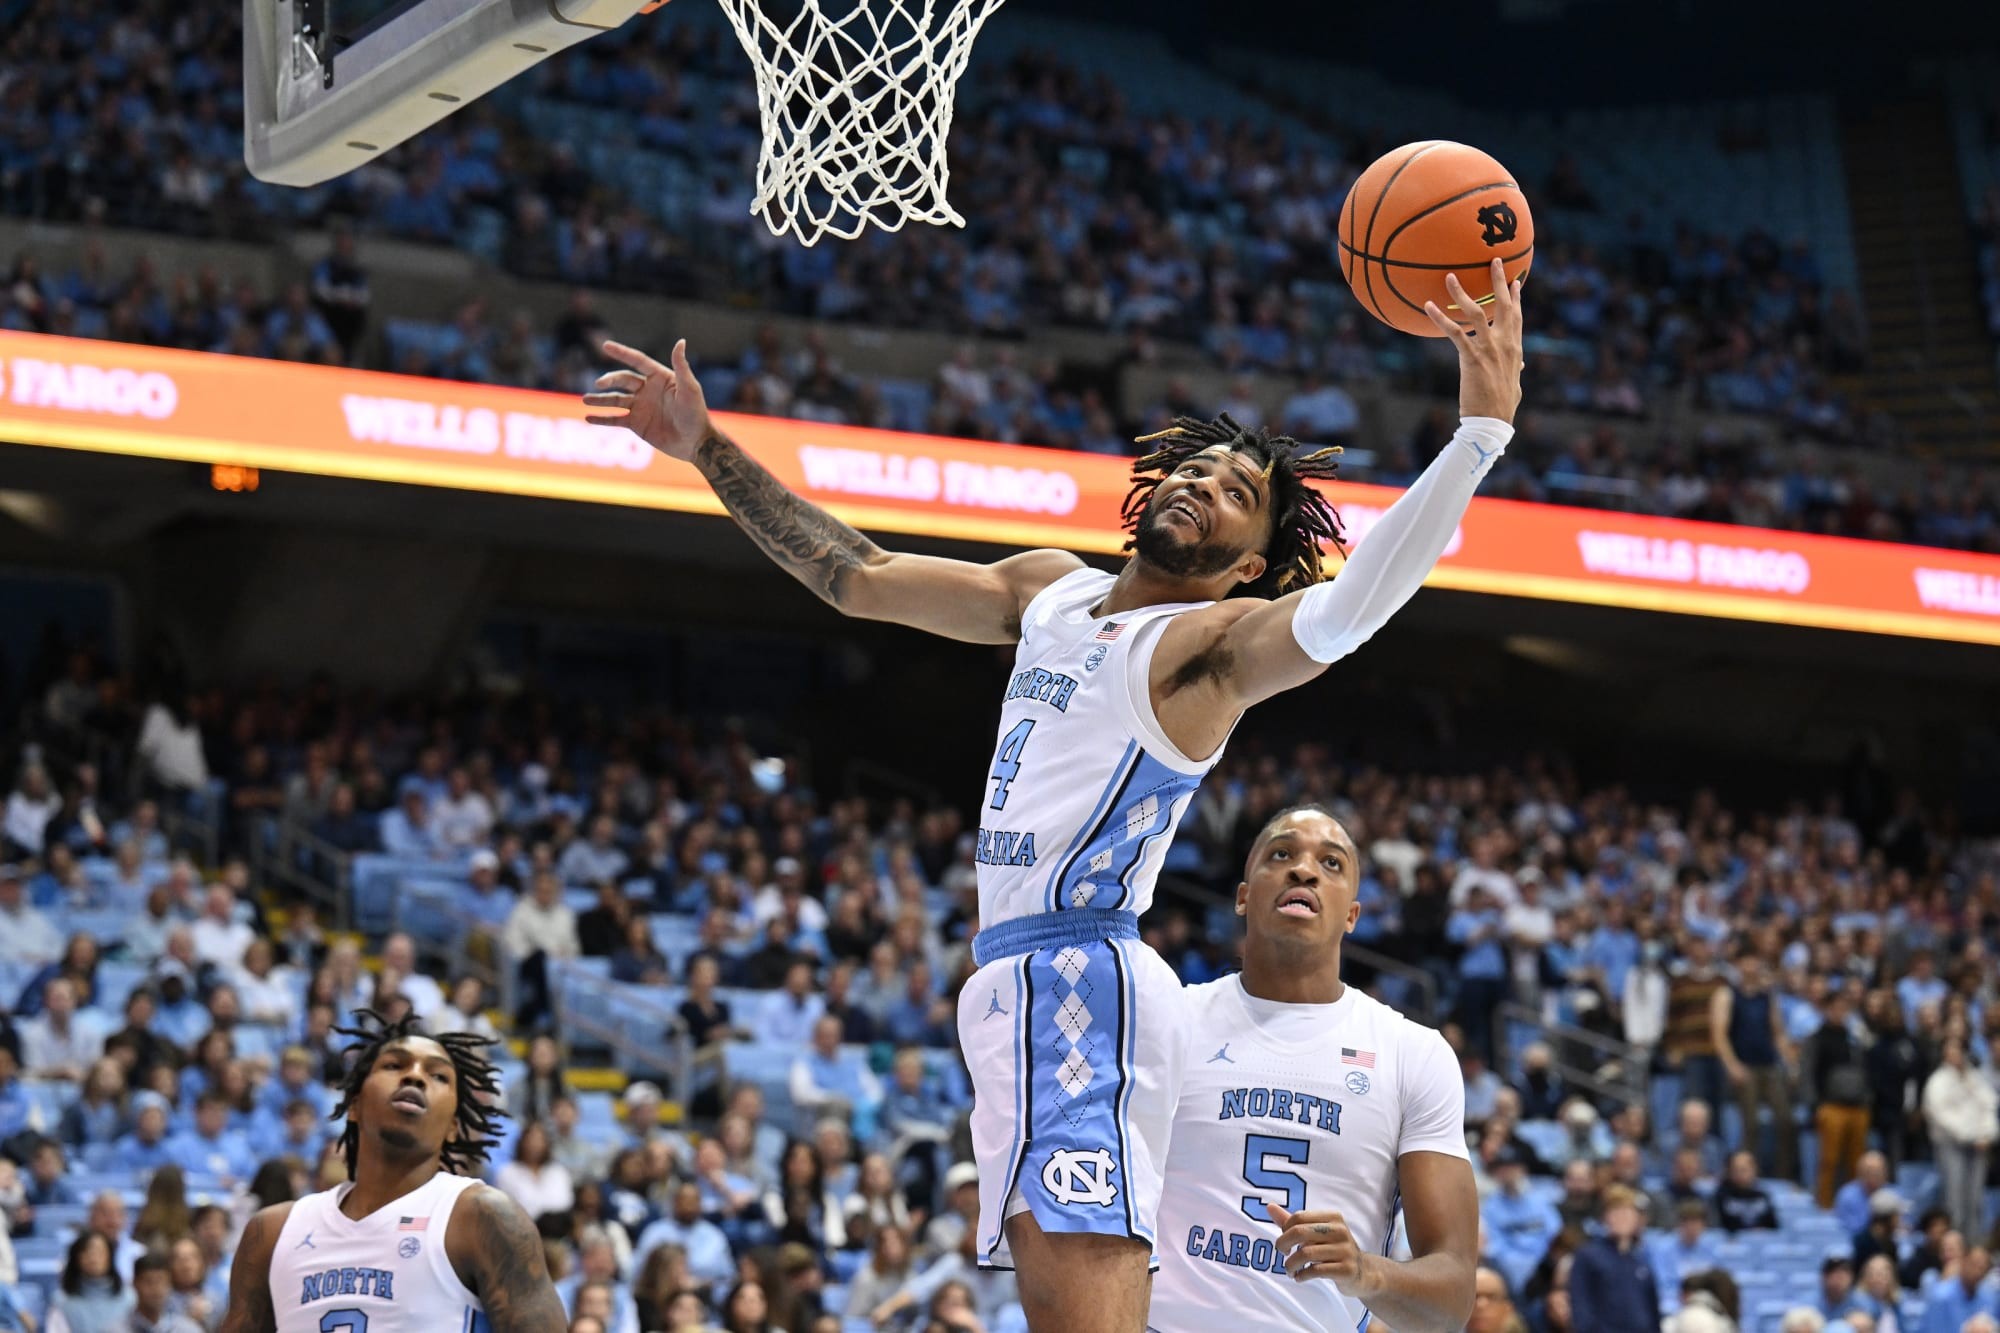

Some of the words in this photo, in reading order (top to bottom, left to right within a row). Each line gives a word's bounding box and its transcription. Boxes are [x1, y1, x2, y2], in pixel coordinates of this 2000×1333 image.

[11, 358, 178, 420] FARGO
[341, 394, 500, 454] WELLS
[504, 411, 655, 471] FARGO
[798, 444, 940, 501] WELLS
[942, 460, 1079, 516] FARGO
[1577, 530, 1696, 583] WELLS
[1697, 543, 1811, 594] FARGO
[990, 718, 1036, 811] 4
[1219, 1087, 1342, 1135] NORTH
[1241, 1133, 1310, 1224] 5
[301, 1267, 393, 1305] NORTH
